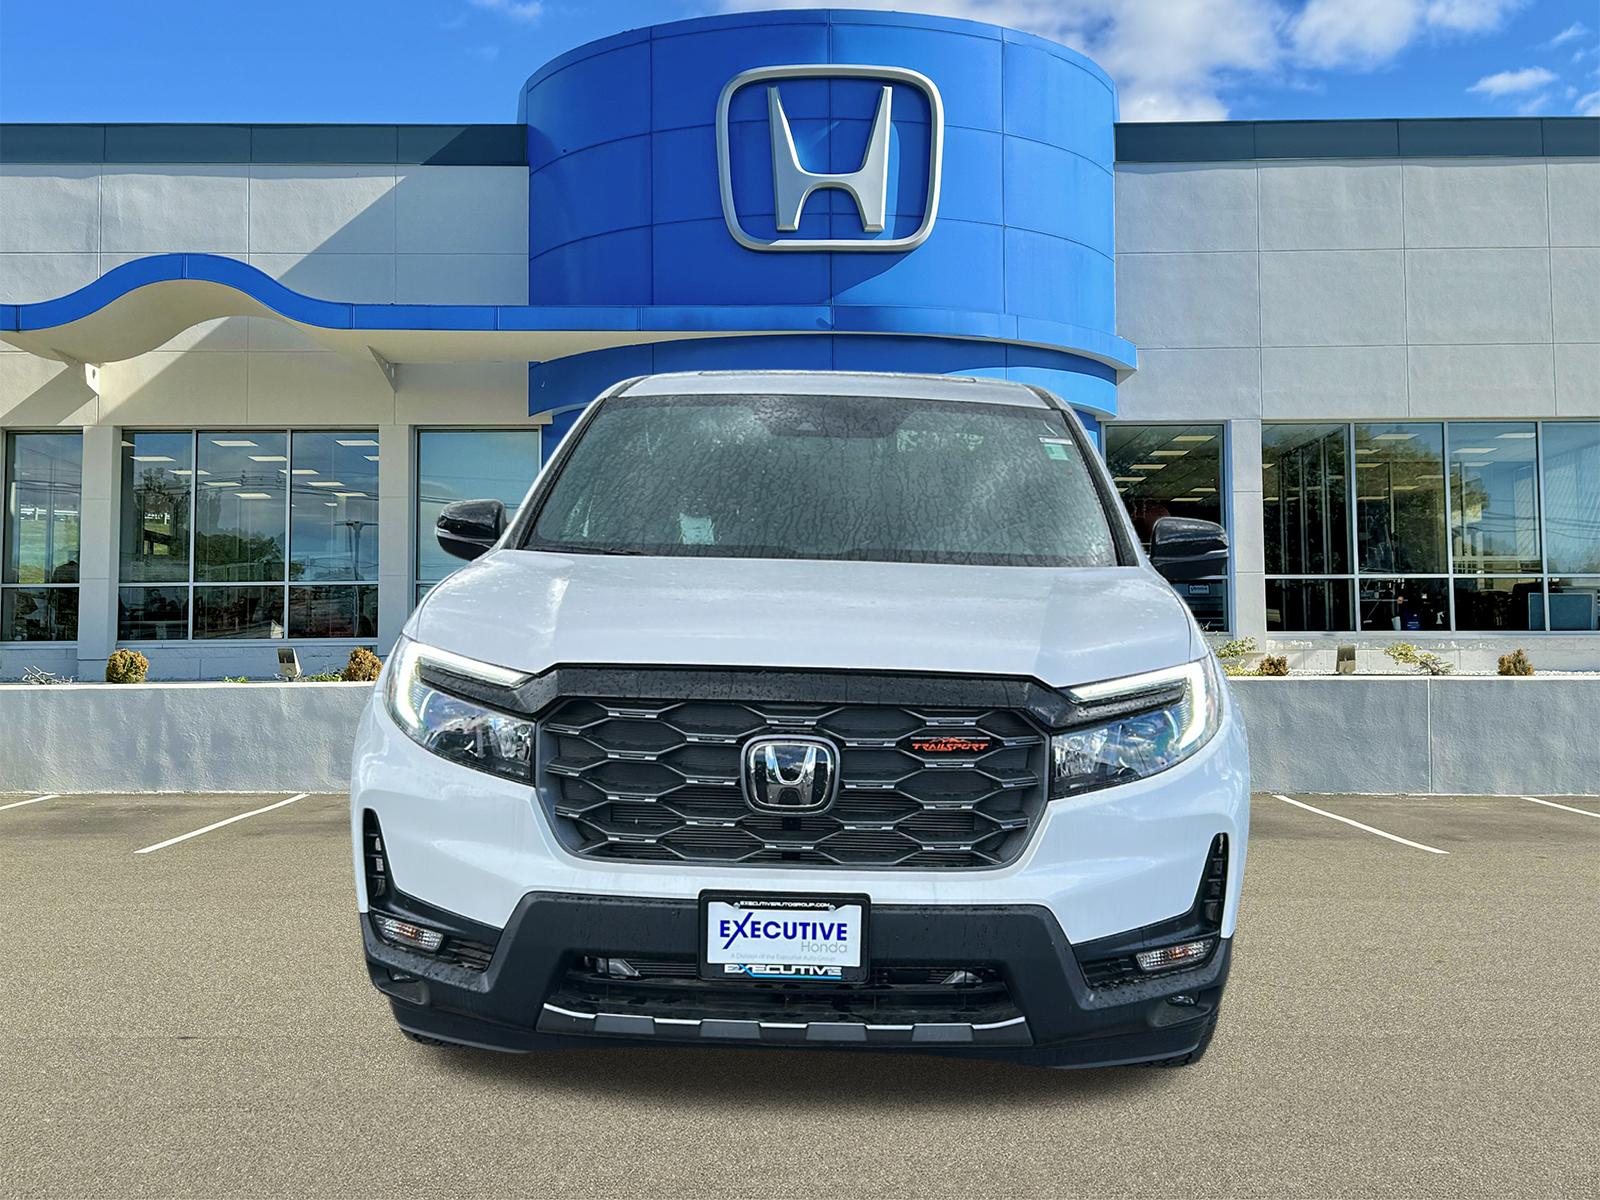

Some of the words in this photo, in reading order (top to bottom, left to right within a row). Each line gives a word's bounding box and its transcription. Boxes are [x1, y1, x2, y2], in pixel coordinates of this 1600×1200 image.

[912, 743, 989, 751] TRAILSPORT
[719, 912, 848, 949] EXECUTIVE
[801, 941, 848, 953] Honda
[724, 963, 842, 976] EXECUTIVE
